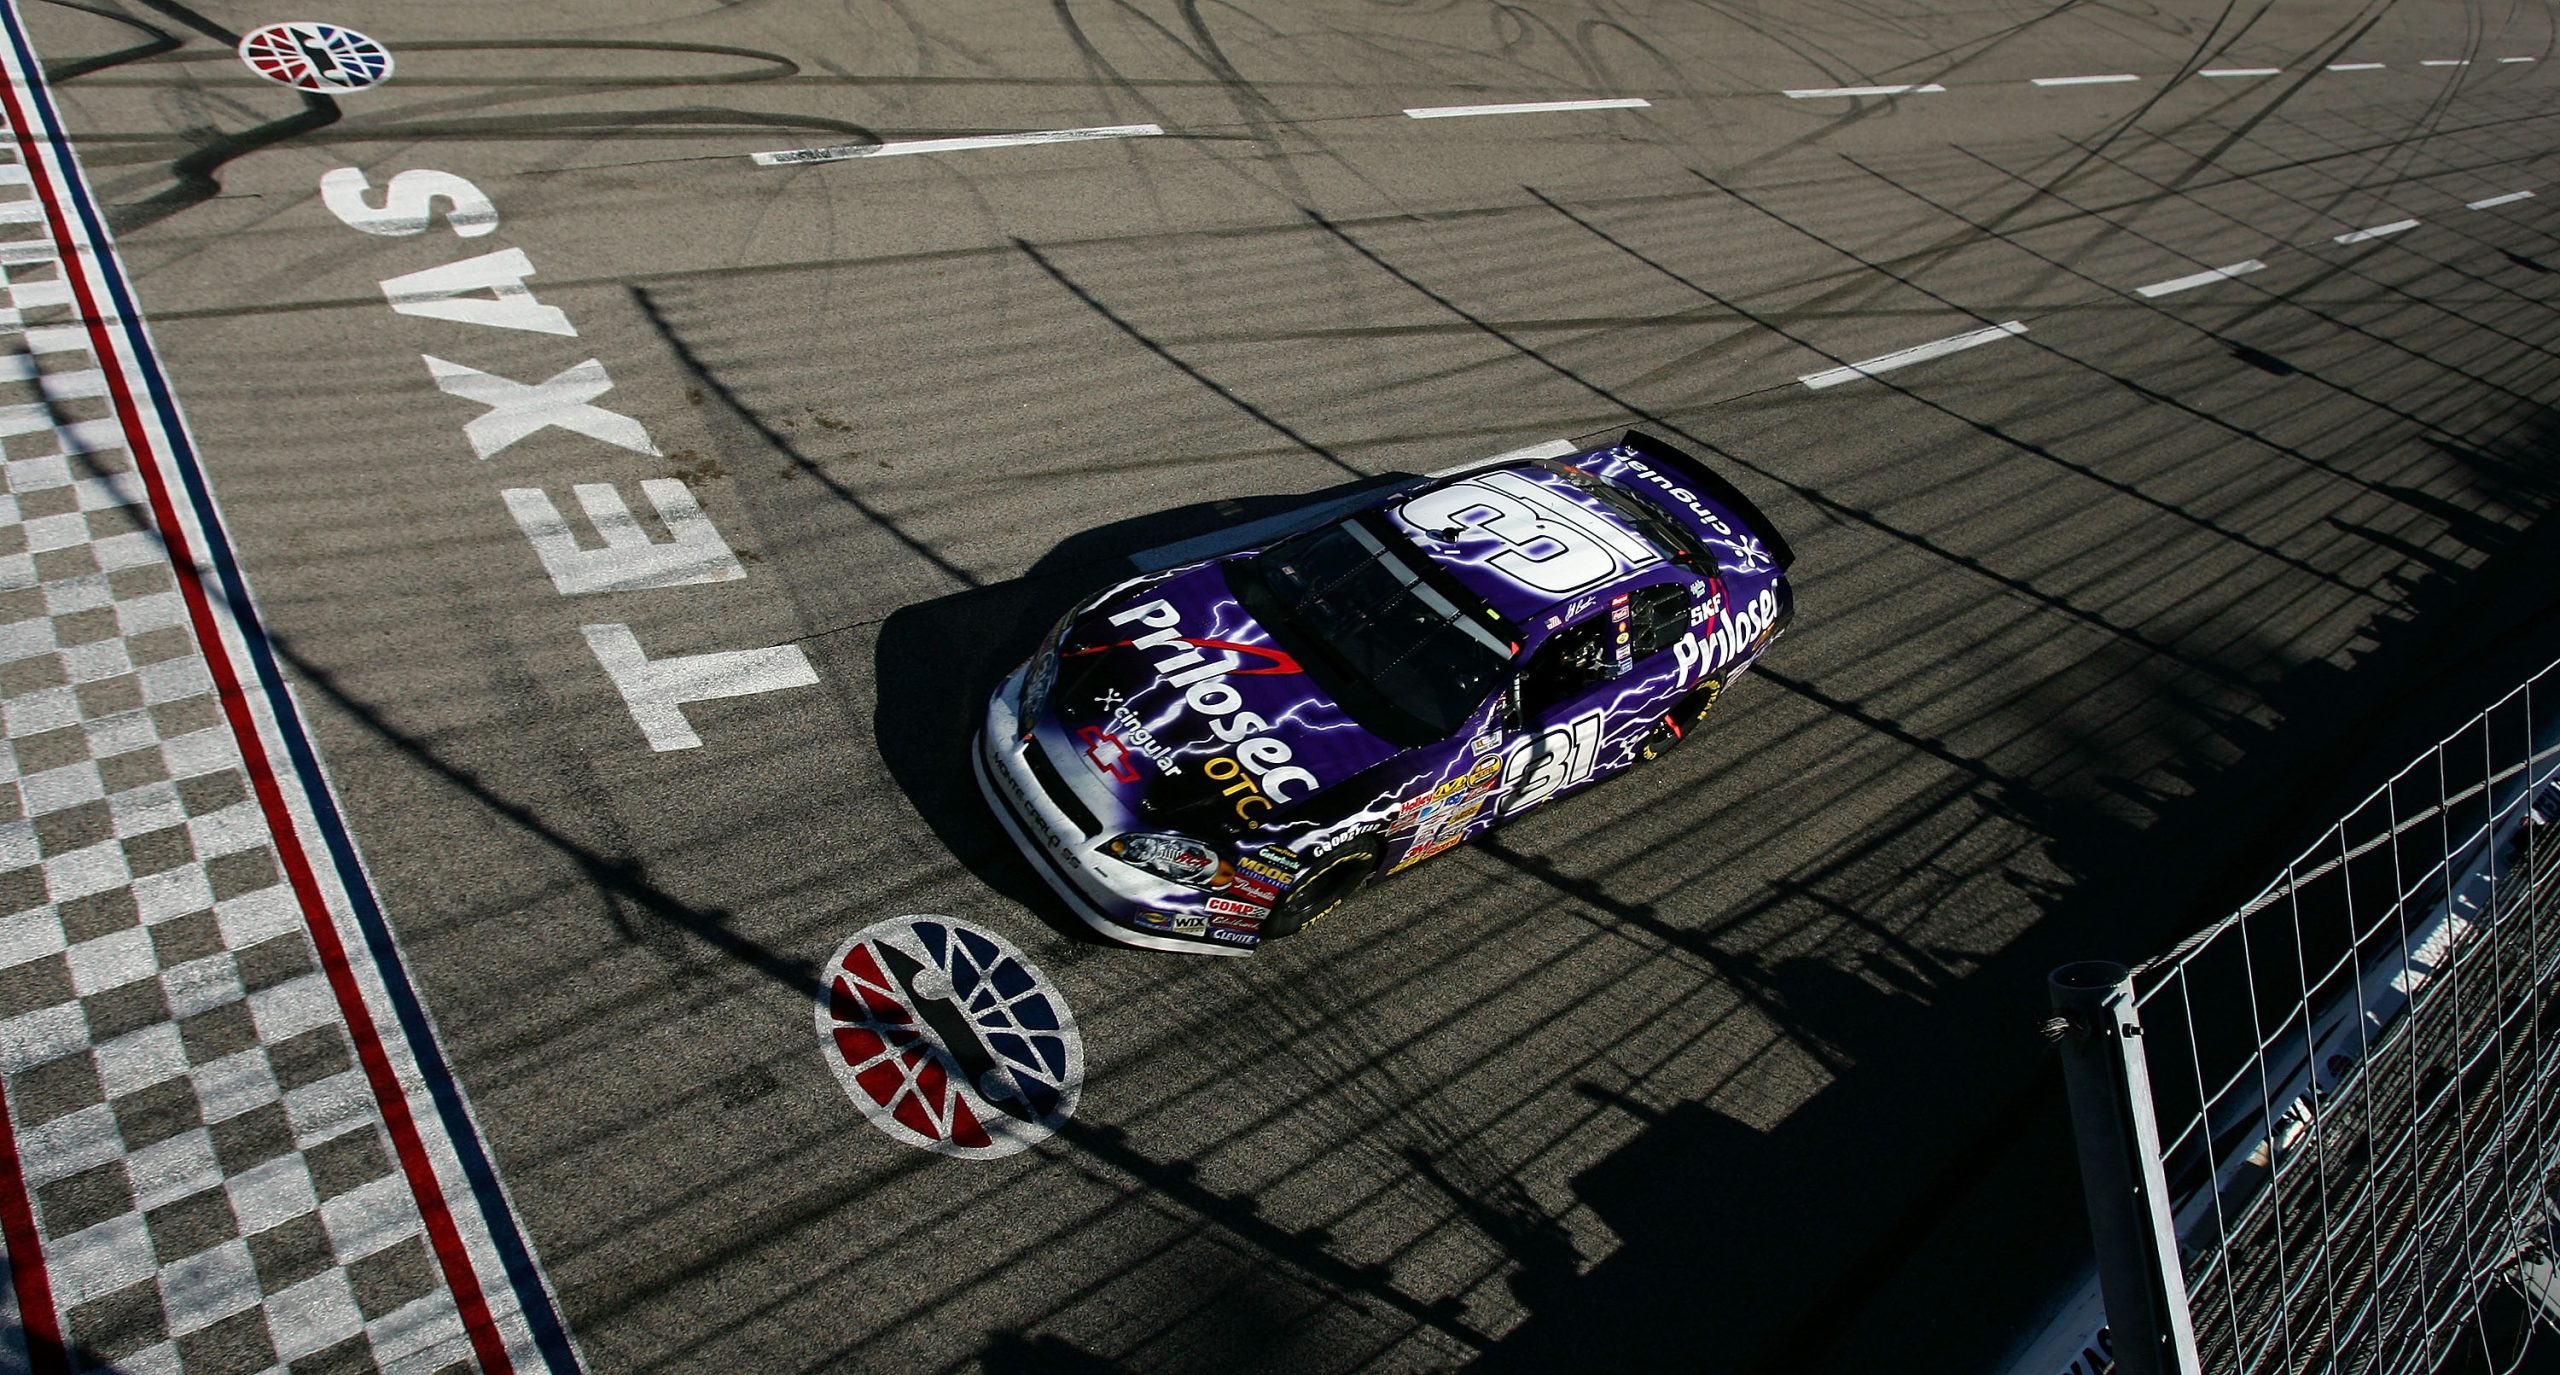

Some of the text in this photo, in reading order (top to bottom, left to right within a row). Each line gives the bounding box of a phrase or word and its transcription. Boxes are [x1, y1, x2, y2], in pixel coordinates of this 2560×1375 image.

[320, 166, 820, 753] TEXAS
[1612, 455, 1732, 536] cingular
[1400, 471, 1657, 594] 31
[1690, 592, 1721, 627] SKF
[1108, 599, 1320, 803] Prilosec
[1114, 706, 1183, 777] cingular
[1497, 712, 1602, 815] 31
[1204, 757, 1273, 821] OTC
[1401, 793, 1433, 814] Holley
[1237, 856, 1294, 885] MOOG
[1175, 917, 1205, 927] WIX
[1209, 899, 1254, 915] COMP
[1213, 929, 1256, 944] CLEVITE
